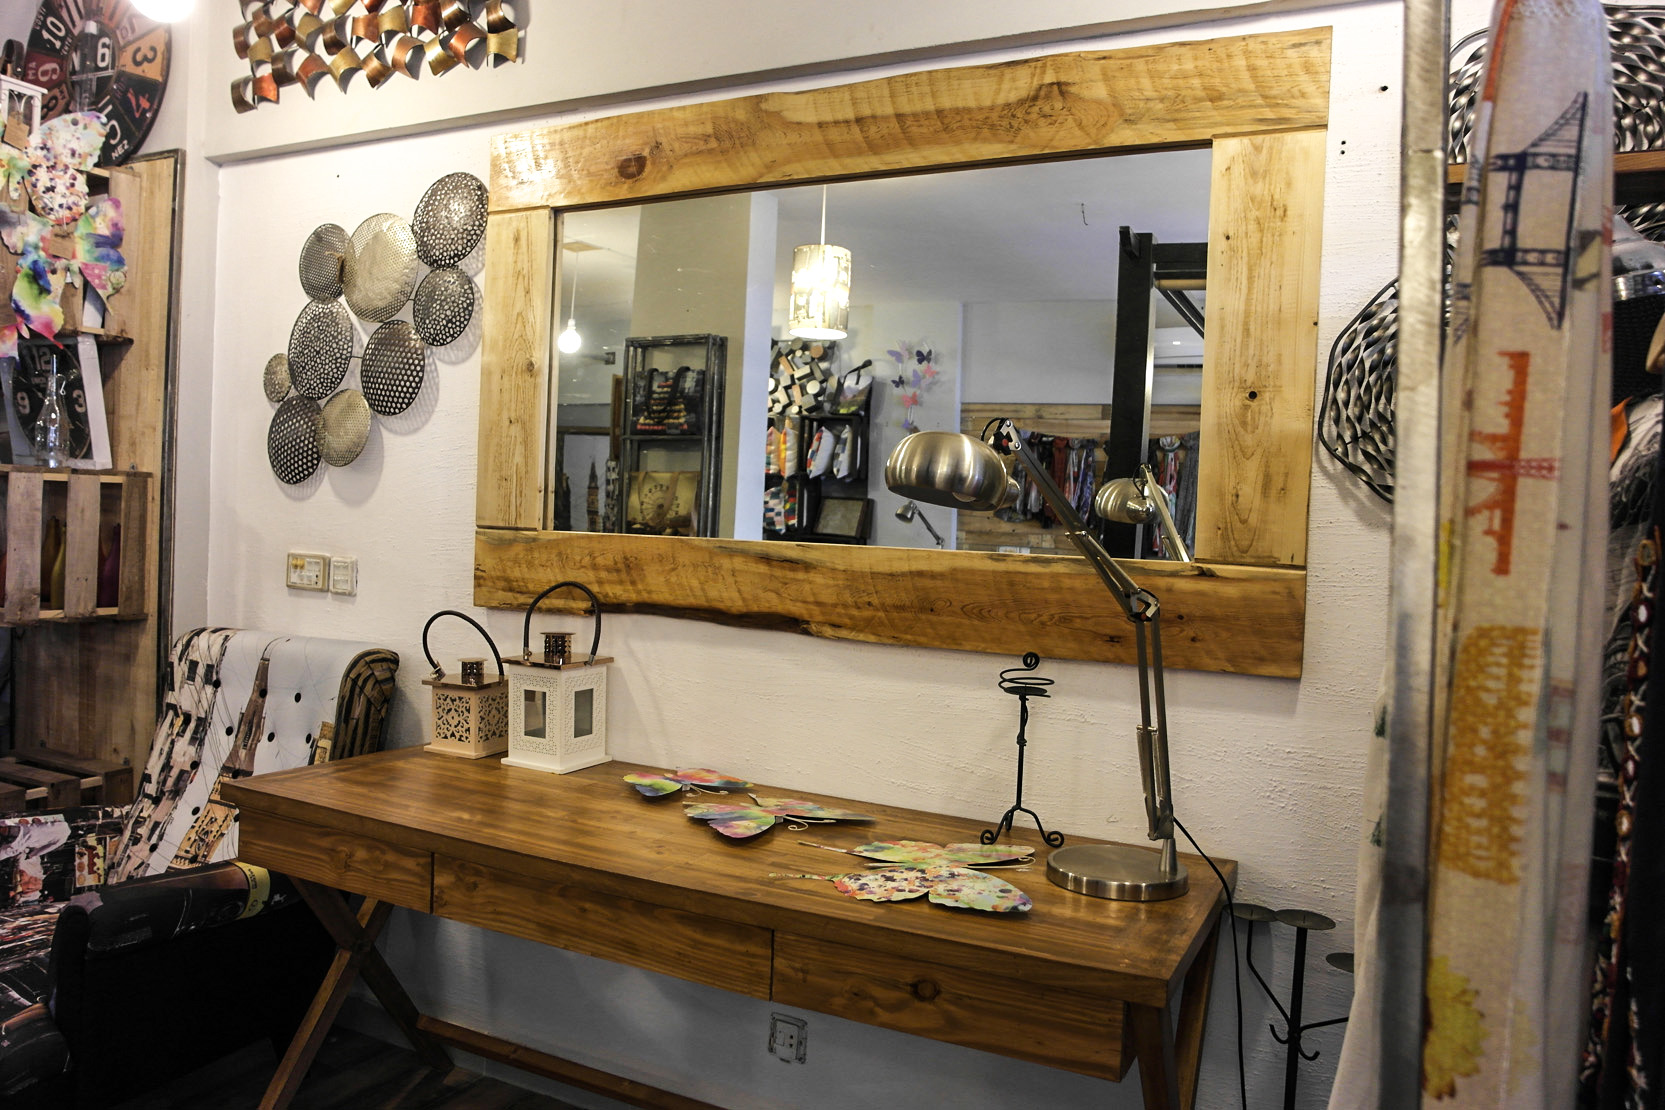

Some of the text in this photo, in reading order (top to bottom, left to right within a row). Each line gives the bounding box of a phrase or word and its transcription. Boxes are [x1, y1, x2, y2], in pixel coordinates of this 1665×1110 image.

[41, 16, 66, 49] 10
[97, 37, 111, 68] 6
[131, 45, 158, 67] 3
[127, 87, 151, 118] 4
[16, 391, 30, 415] 9
[72, 389, 86, 414] 3
